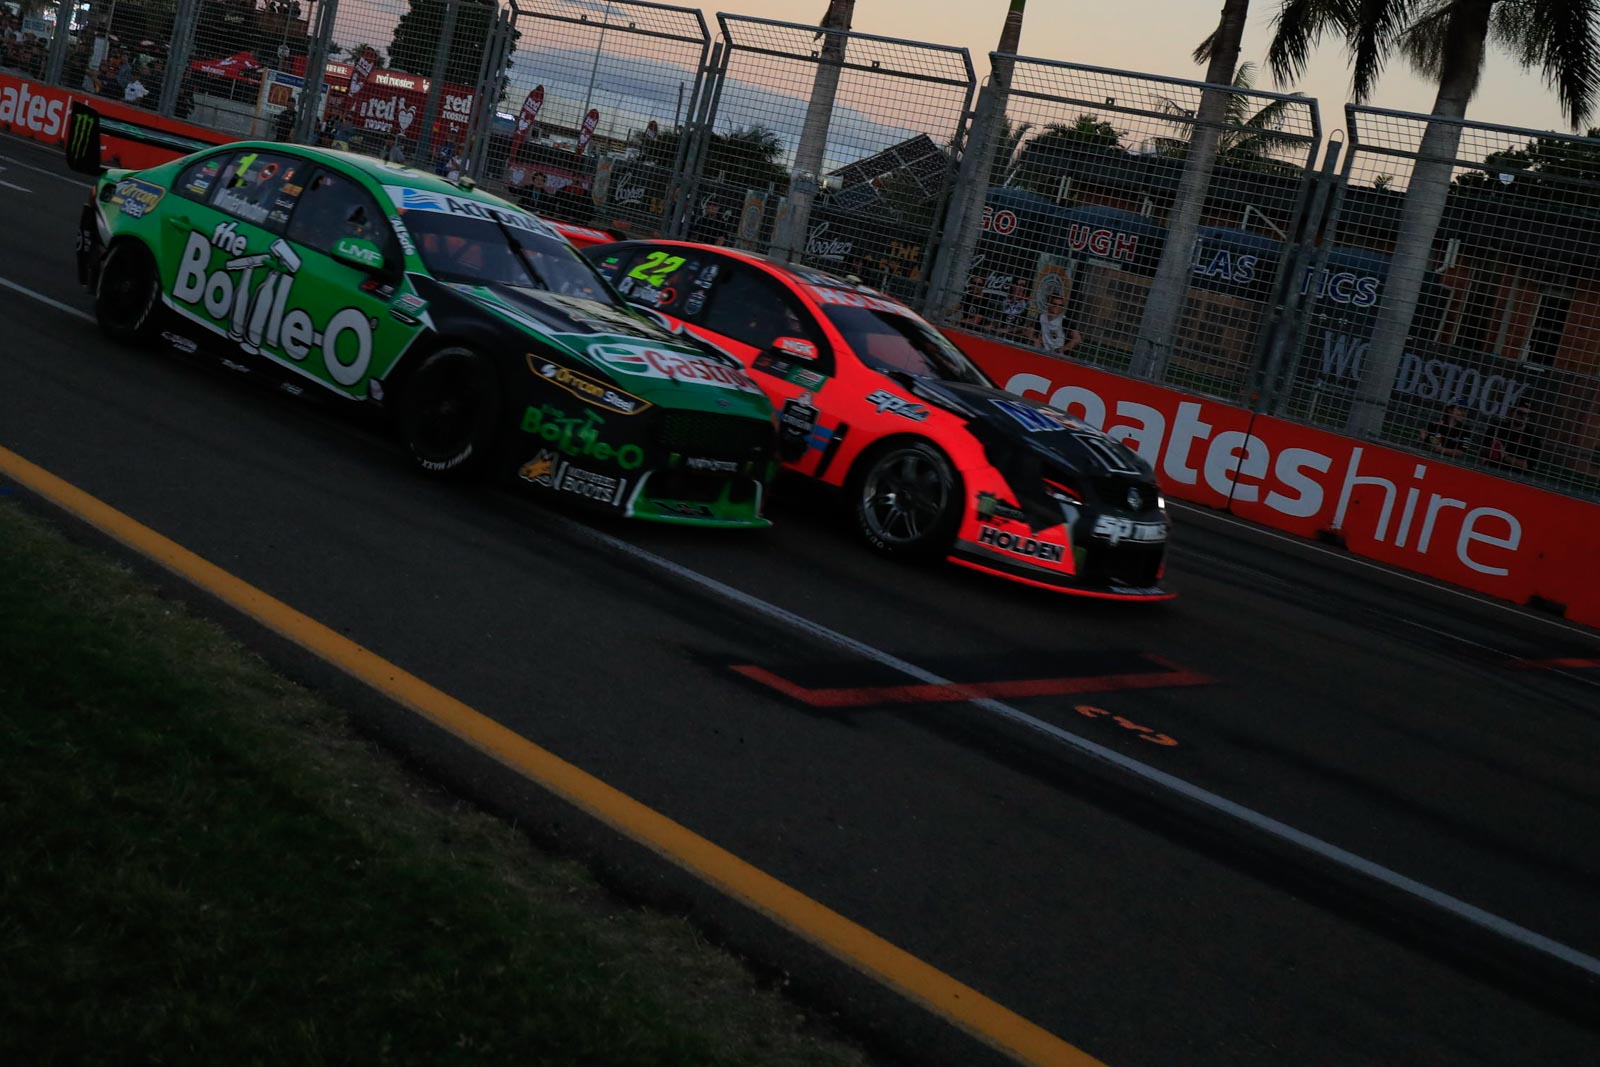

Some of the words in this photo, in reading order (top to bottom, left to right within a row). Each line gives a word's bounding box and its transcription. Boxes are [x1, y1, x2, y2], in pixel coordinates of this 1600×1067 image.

[0, 83, 64, 136] ates
[367, 96, 397, 121] red
[443, 94, 473, 114] red
[210, 220, 248, 256] the
[337, 239, 383, 262] LMF
[1067, 223, 1139, 262] UGH
[627, 250, 688, 287] 22
[1321, 329, 1530, 418] WDSTOCK
[561, 475, 614, 503] BOOTS
[1331, 446, 1523, 577] hire
[979, 525, 1064, 562] HOLDEN
